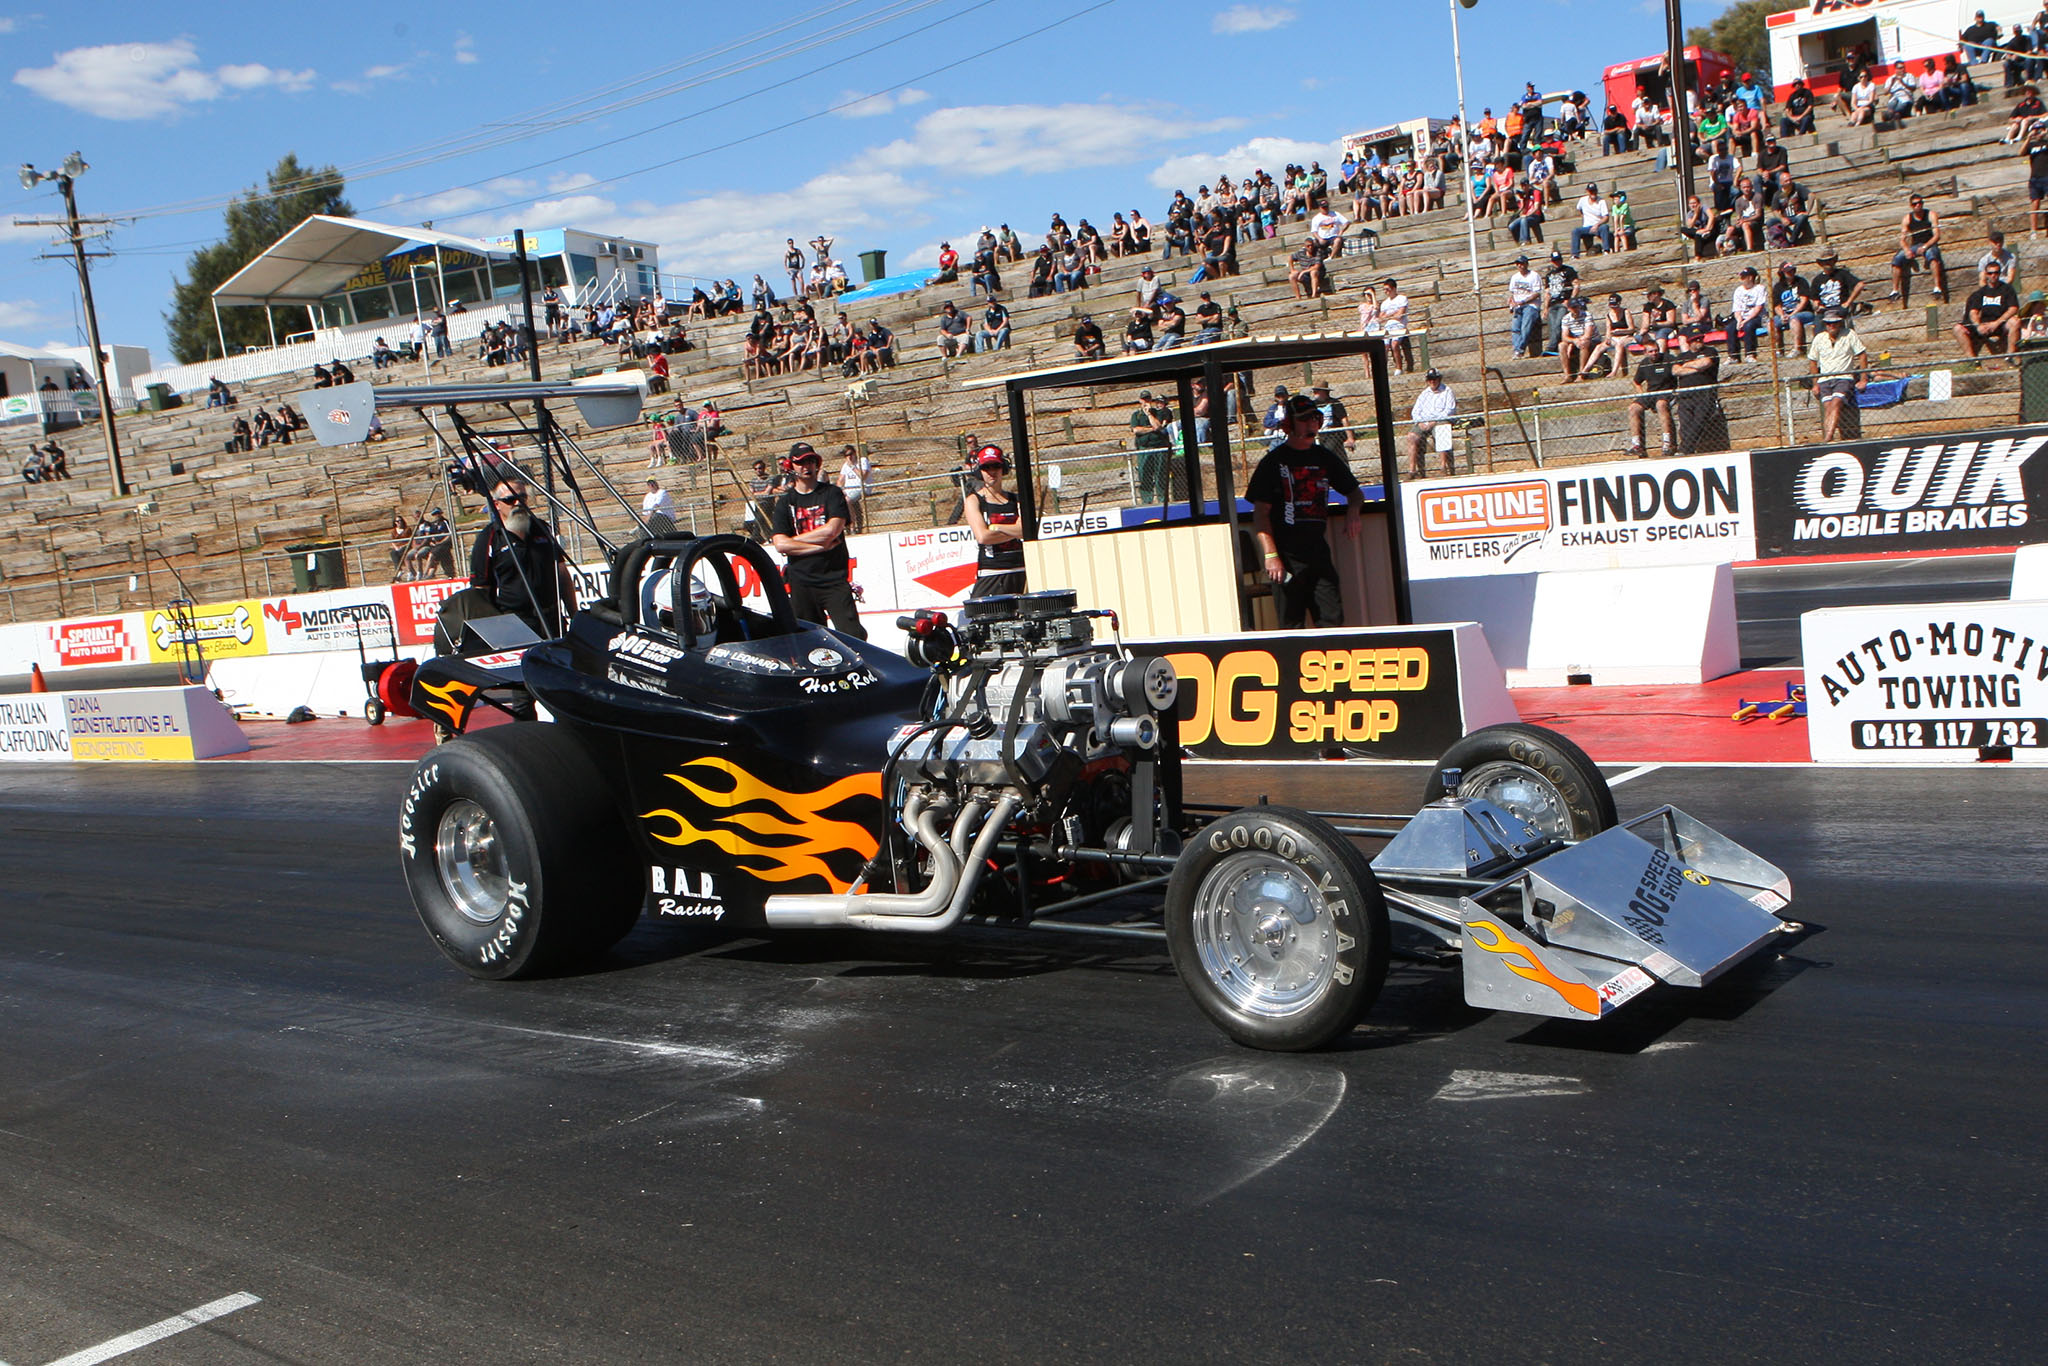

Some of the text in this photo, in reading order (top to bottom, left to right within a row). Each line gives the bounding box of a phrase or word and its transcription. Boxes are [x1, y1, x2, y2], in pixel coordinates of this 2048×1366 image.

[1376, 130, 1396, 139] FOOD
[343, 272, 387, 291] JANE
[1792, 435, 2048, 515] QUIK
[1557, 465, 1739, 526] FINDON
[1042, 516, 1108, 534] SPARES
[1793, 504, 2029, 541] MOBILE BRAKES
[899, 530, 976, 547] JUST COM
[1562, 521, 1740, 546] EXHAUST SPECIALIST
[1430, 541, 1500, 560] MUFFLERS
[409, 581, 471, 604] METR
[68, 626, 115, 643] SPRINT
[307, 627, 391, 641] AUTO DYNO CENTR
[70, 645, 116, 657] AUTO PARTS
[640, 650, 672, 664] SHOP
[647, 641, 685, 659] SPEED
[730, 651, 779, 670] LEONARD
[1300, 647, 1429, 693] SPEED
[800, 669, 878, 694] Hot Rod
[1879, 674, 2021, 709] TOWING
[0, 702, 47, 725] TRALIAN
[68, 697, 101, 714] DIANA
[72, 715, 179, 734] CONSTRUCTIONS PL
[1290, 700, 1398, 742] SHOP
[1862, 721, 2038, 747] 0412 117 732
[76, 741, 145, 756] CONCRETING
[1641, 849, 1670, 891] SPEED
[1659, 866, 1684, 902] SHOP
[659, 898, 725, 921] Racing
